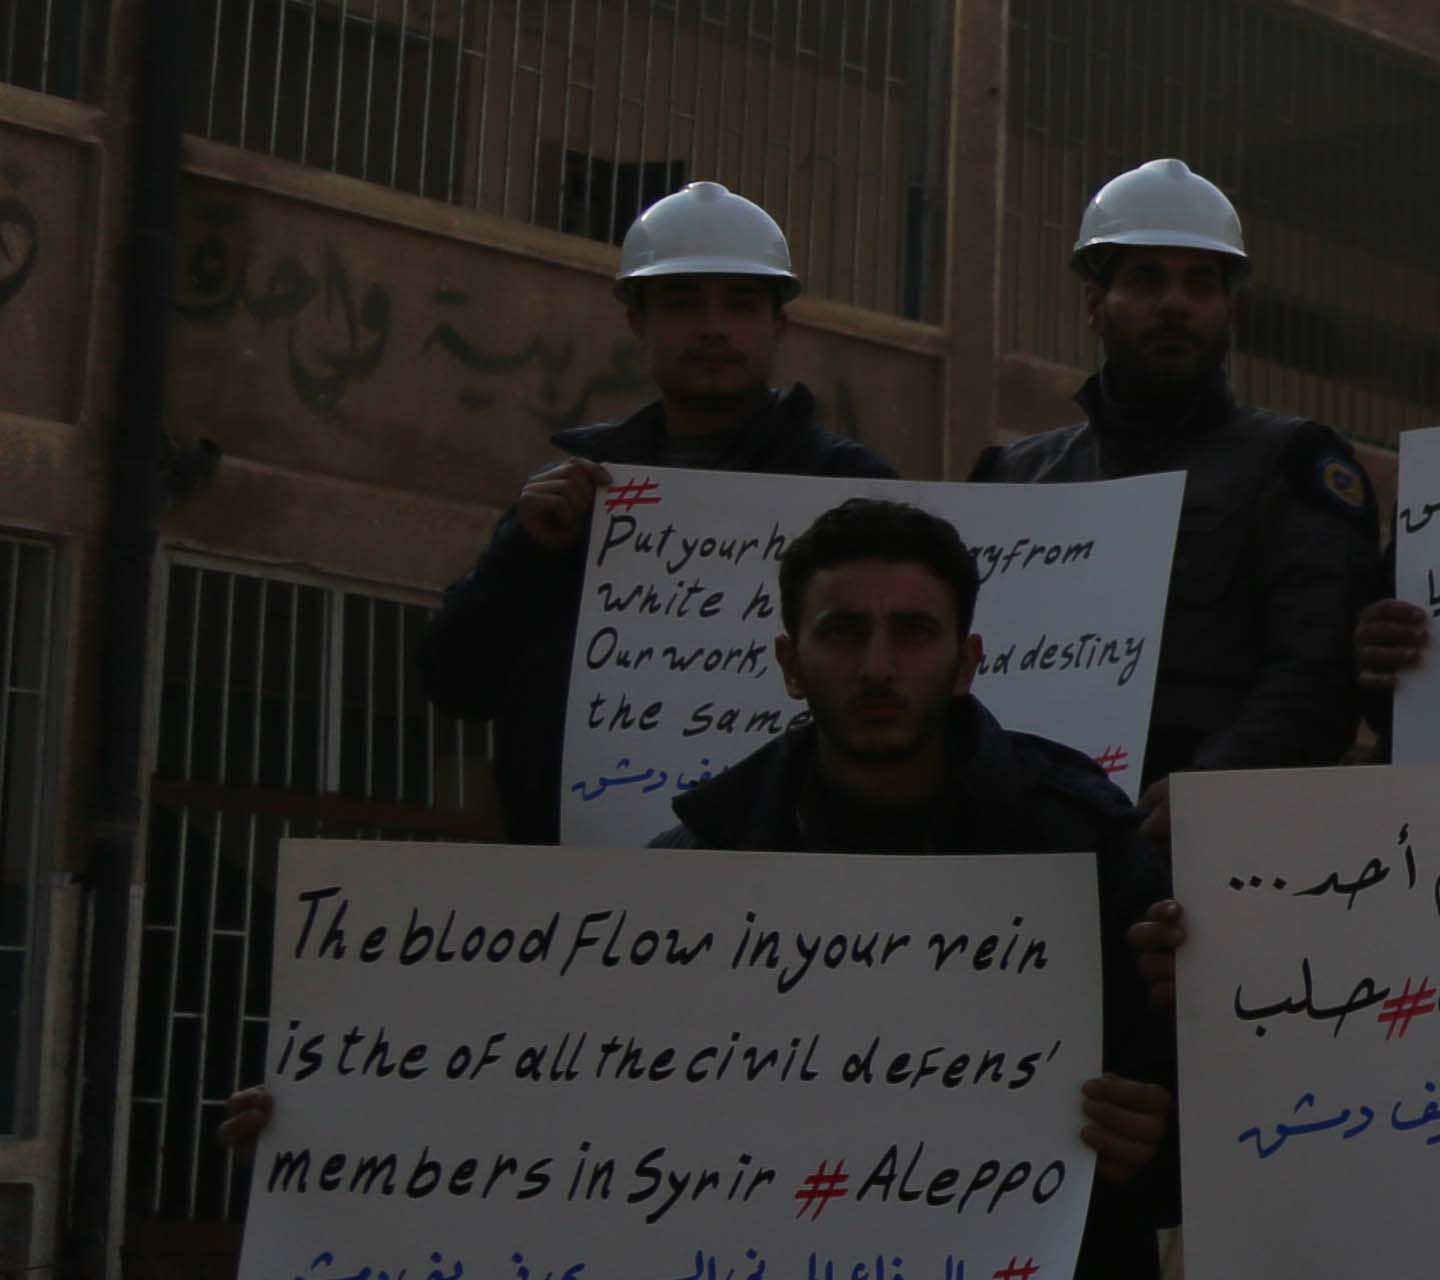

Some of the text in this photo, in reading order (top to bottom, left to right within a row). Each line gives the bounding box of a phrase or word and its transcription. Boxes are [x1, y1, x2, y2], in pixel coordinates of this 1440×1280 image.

[597, 513, 677, 567] Put
[666, 533, 760, 575] your
[1001, 538, 1095, 573] from
[586, 627, 653, 671] Our
[1020, 633, 1146, 687] destiny
[587, 693, 663, 732] the
[1292, 822, 1417, 910] أحد
[295, 886, 389, 964] The
[399, 907, 562, 966] blood
[731, 911, 780, 969] in
[777, 931, 910, 994] your
[927, 916, 1049, 974] vein
[276, 1020, 325, 1081] is
[337, 1026, 429, 1080] the
[446, 1032, 507, 1080] of
[515, 1031, 588, 1081] all
[596, 1035, 677, 1081] the
[686, 1031, 820, 1082] civil
[1237, 1092, 1375, 1159] دمشق
[267, 1146, 555, 1199] members
[567, 1141, 615, 1201] in
